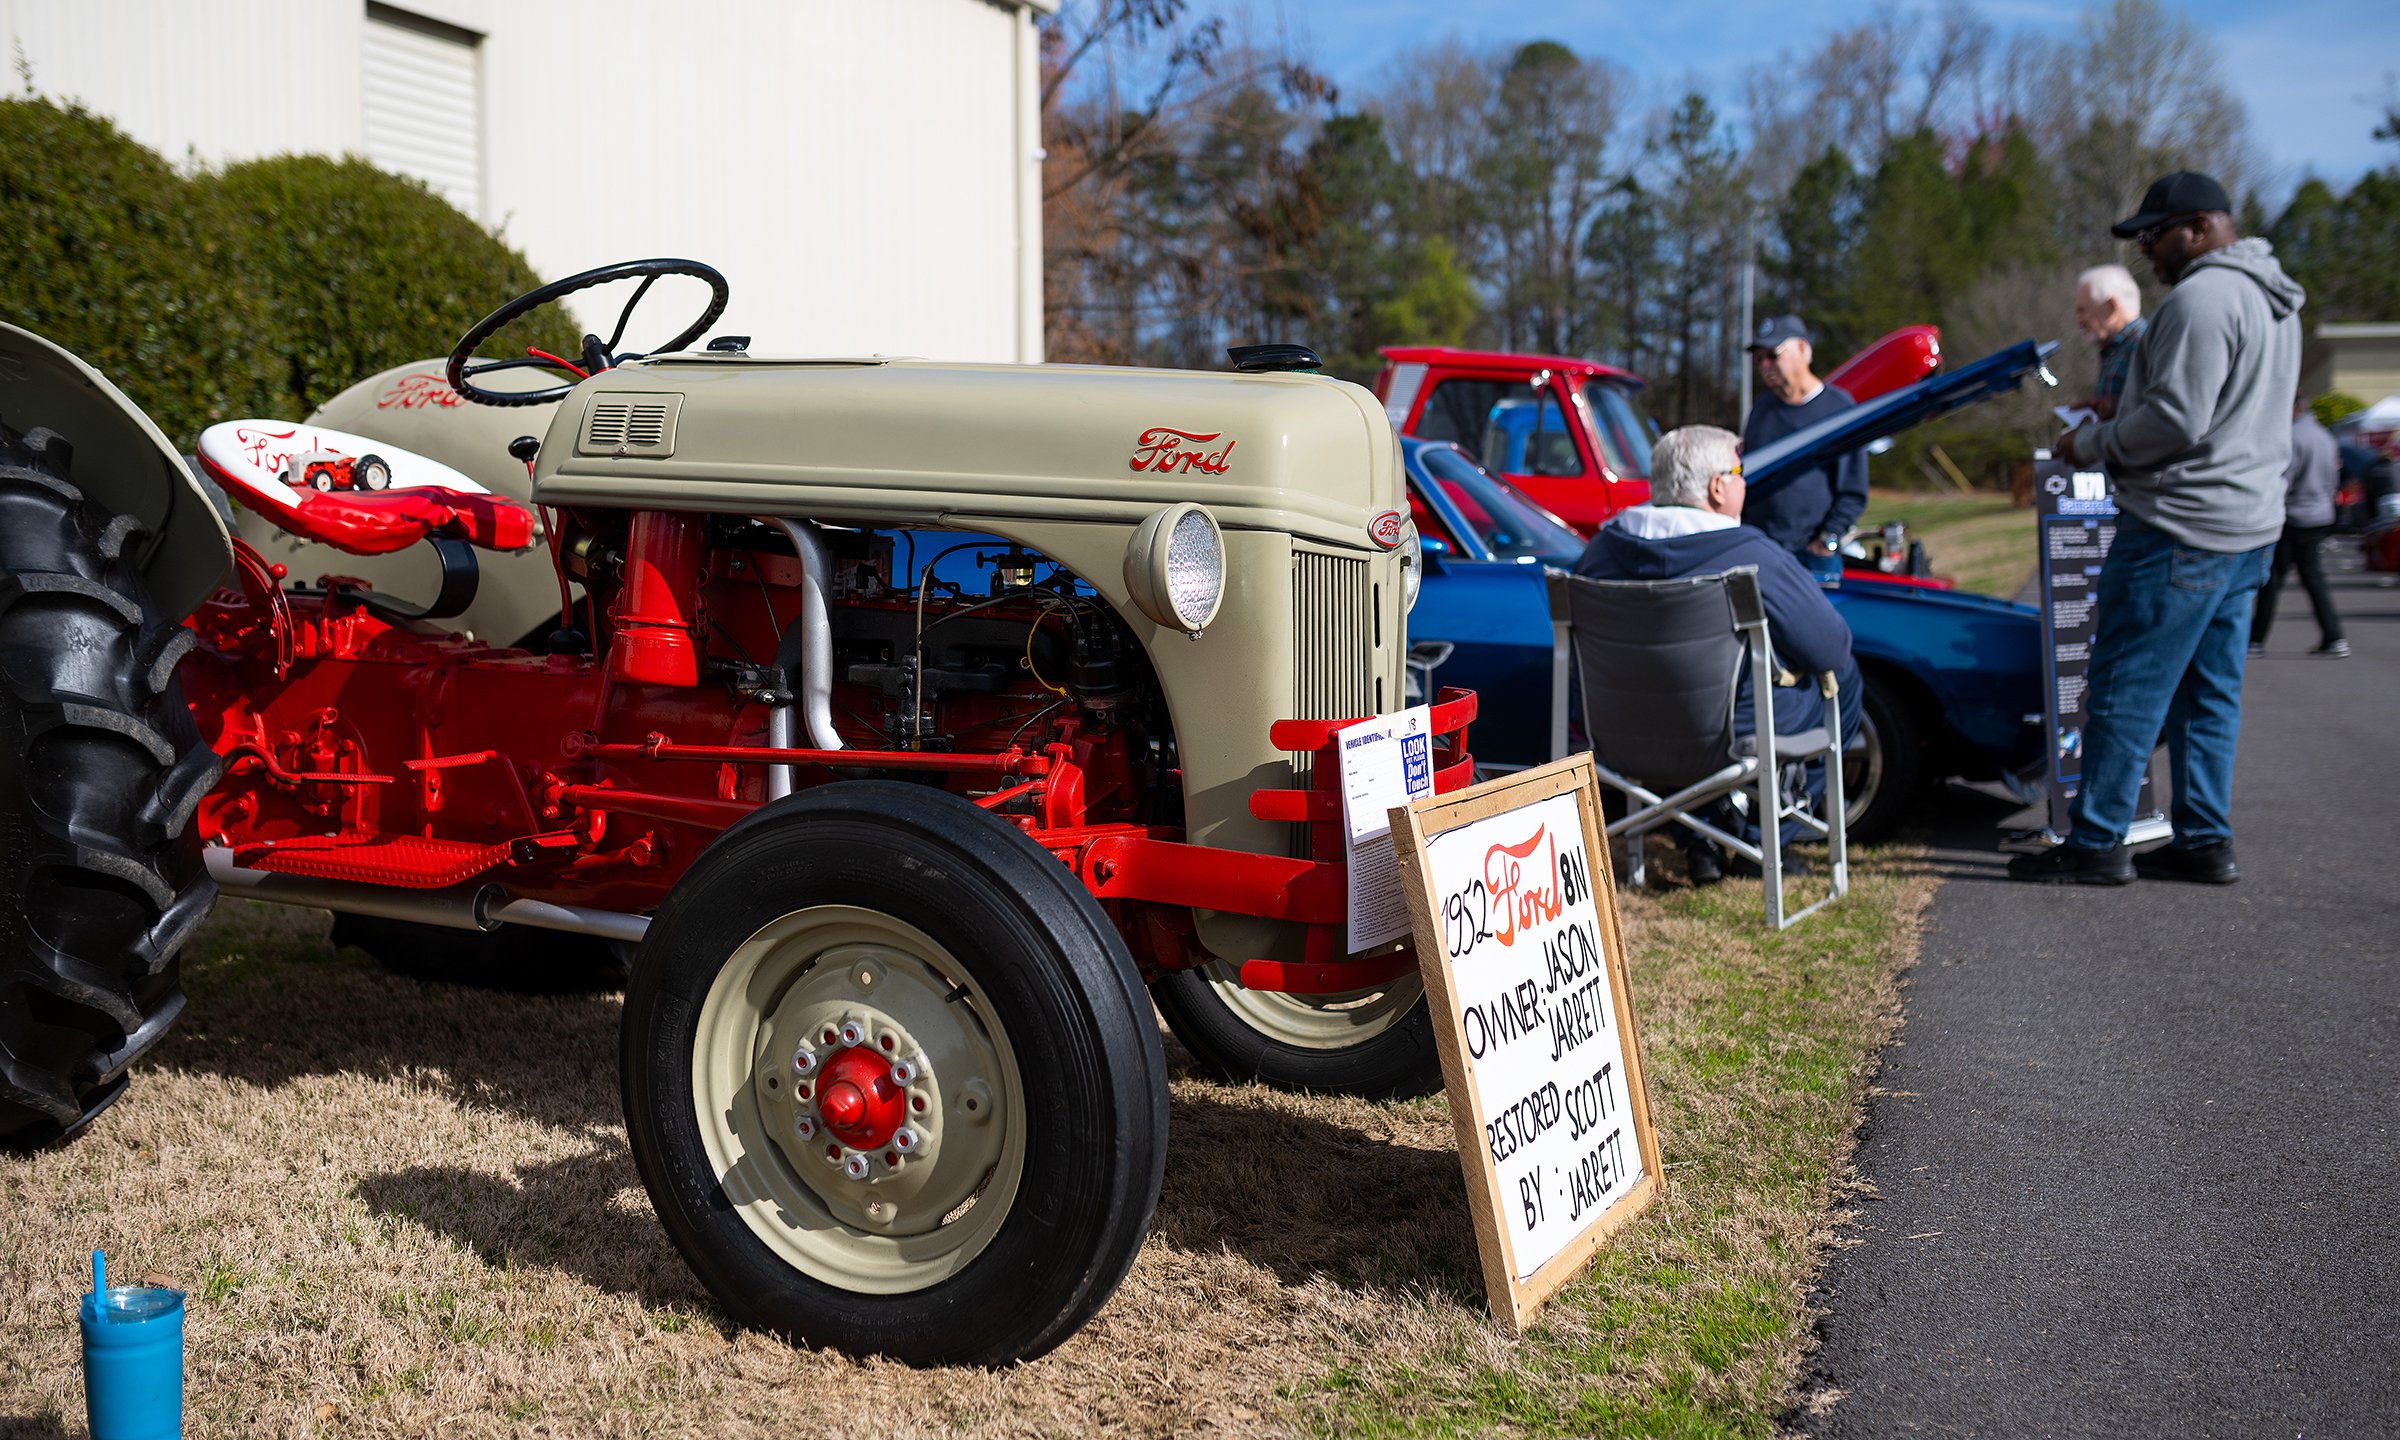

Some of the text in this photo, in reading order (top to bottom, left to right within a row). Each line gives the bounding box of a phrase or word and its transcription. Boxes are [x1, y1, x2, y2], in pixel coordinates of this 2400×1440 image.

[1130, 427, 1236, 475] Ford
[1345, 737, 1361, 750] VEHICLE
[1402, 737, 1426, 758] LOOK
[1408, 717, 1417, 731] 18
[1407, 760, 1426, 778] Don't
[1407, 774, 1429, 793] Touch
[1442, 877, 1493, 958] 1952
[1485, 822, 1562, 947] Ford
[1560, 846, 1588, 906] 8N
[1543, 920, 1600, 993] JASON
[1548, 976, 1605, 1062] JARRETT
[1486, 1062, 1615, 1166] RESTORED SCOTT
[1569, 1128, 1625, 1221] JARRETT
